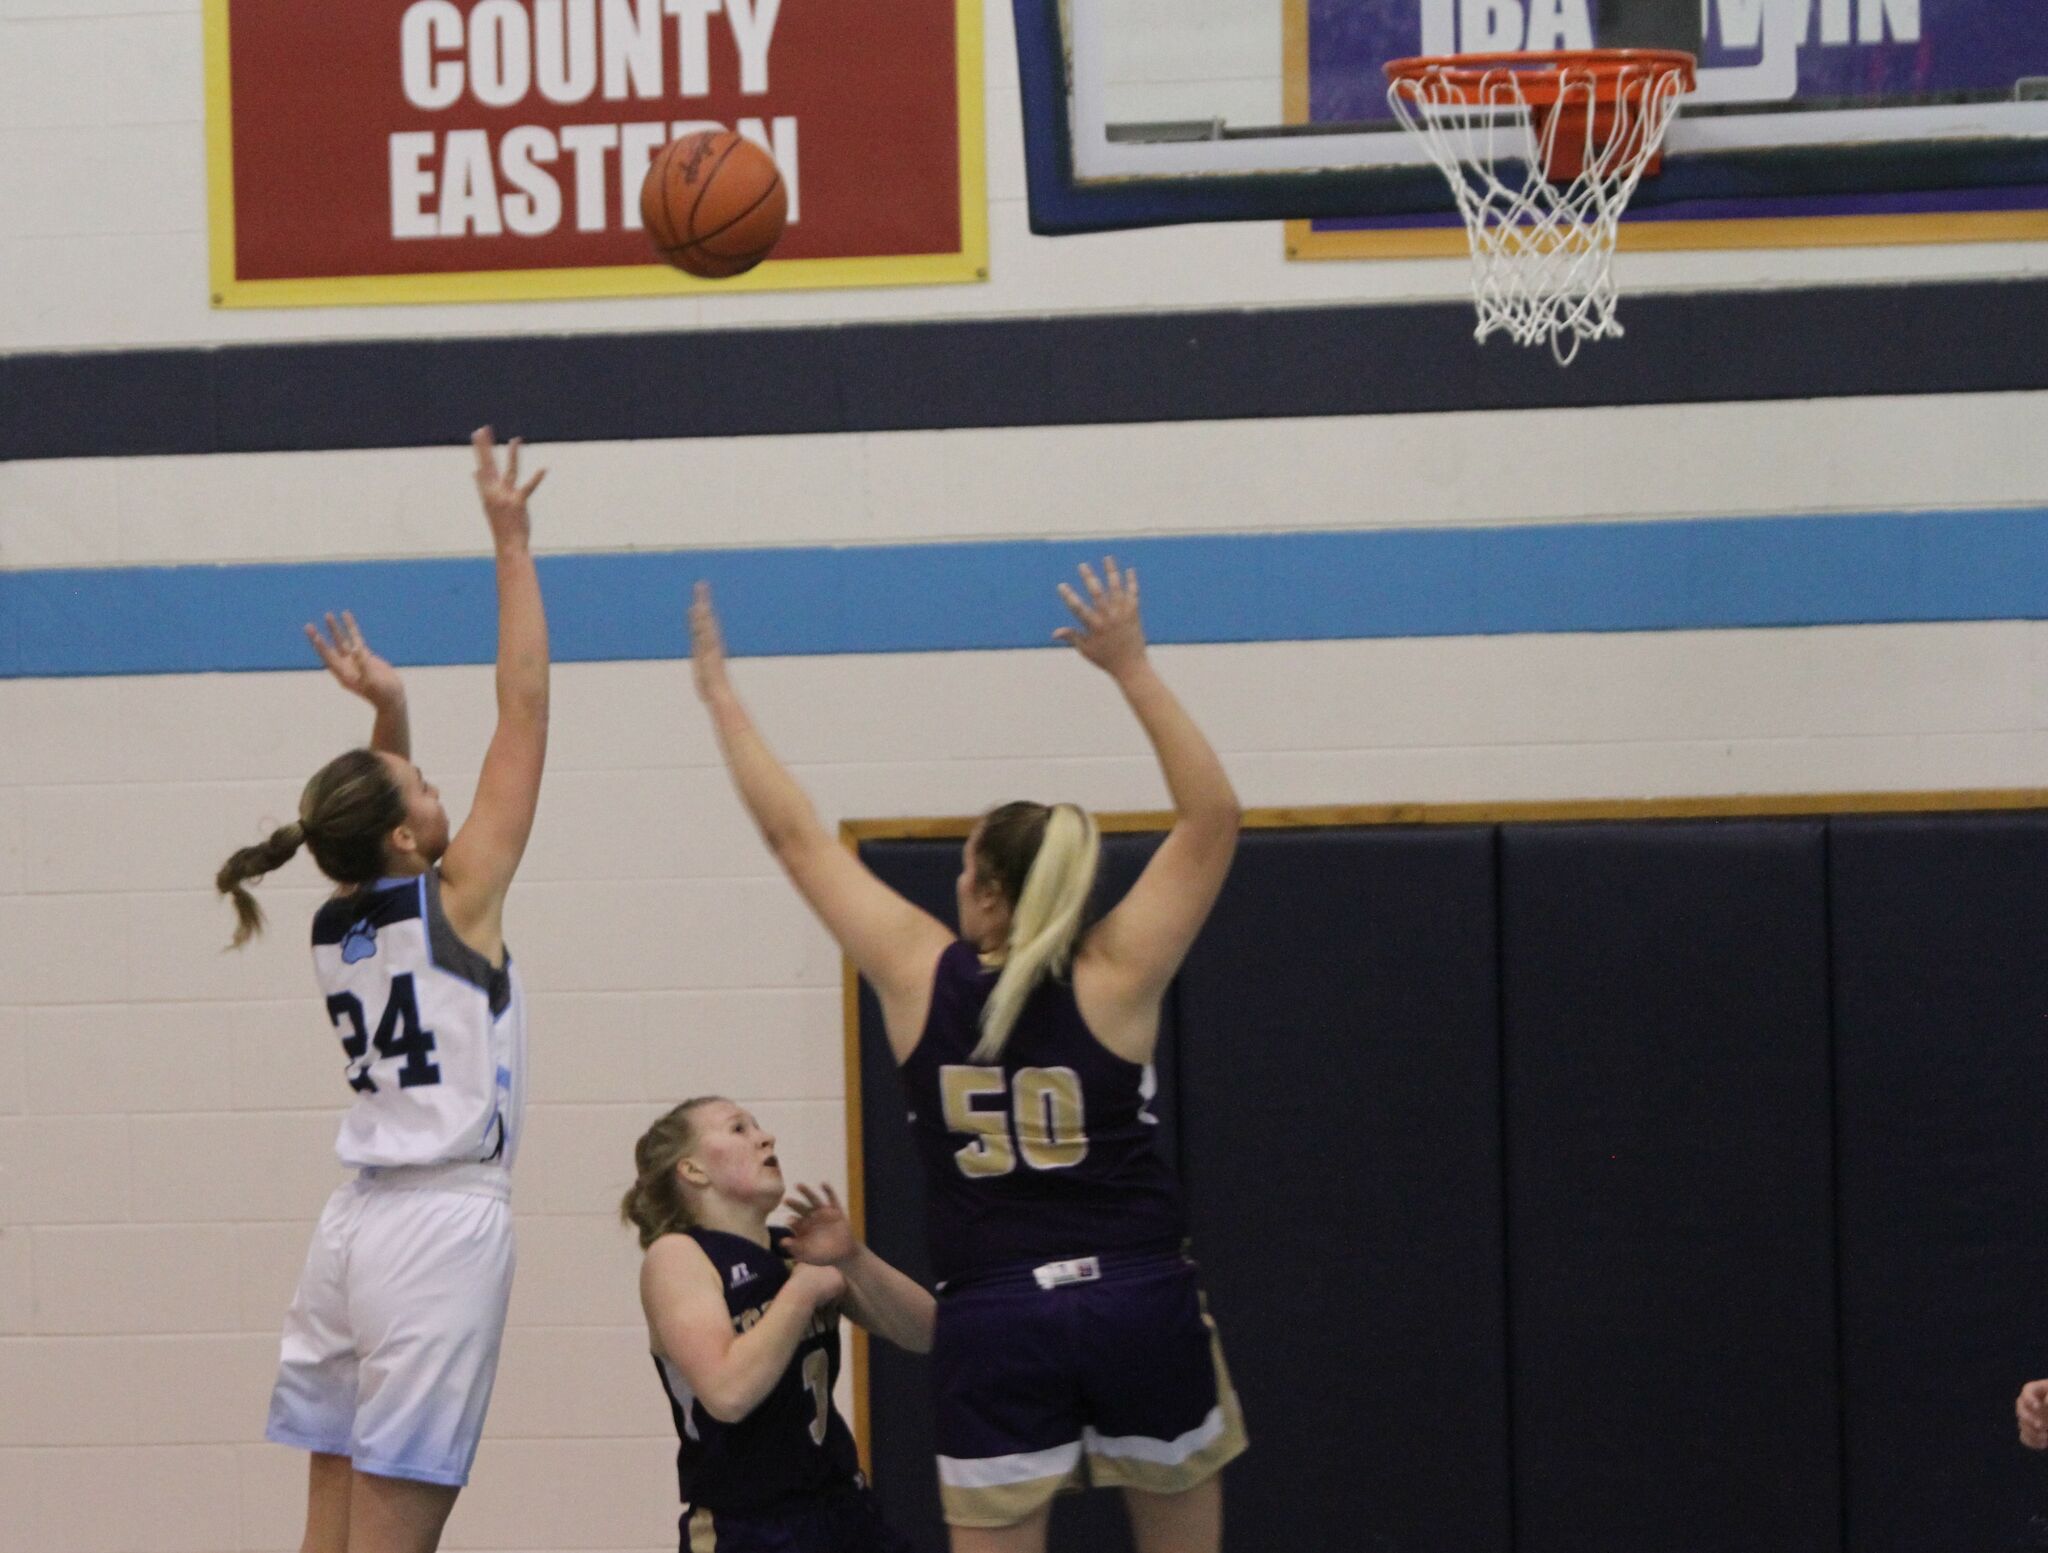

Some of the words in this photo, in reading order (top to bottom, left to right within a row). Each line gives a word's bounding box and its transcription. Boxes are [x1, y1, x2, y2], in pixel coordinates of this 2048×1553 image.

[401, 0, 781, 109] COUNTY
[389, 116, 799, 238] EASTEN
[326, 971, 441, 1093] 24
[939, 1064, 1089, 1178] 50
